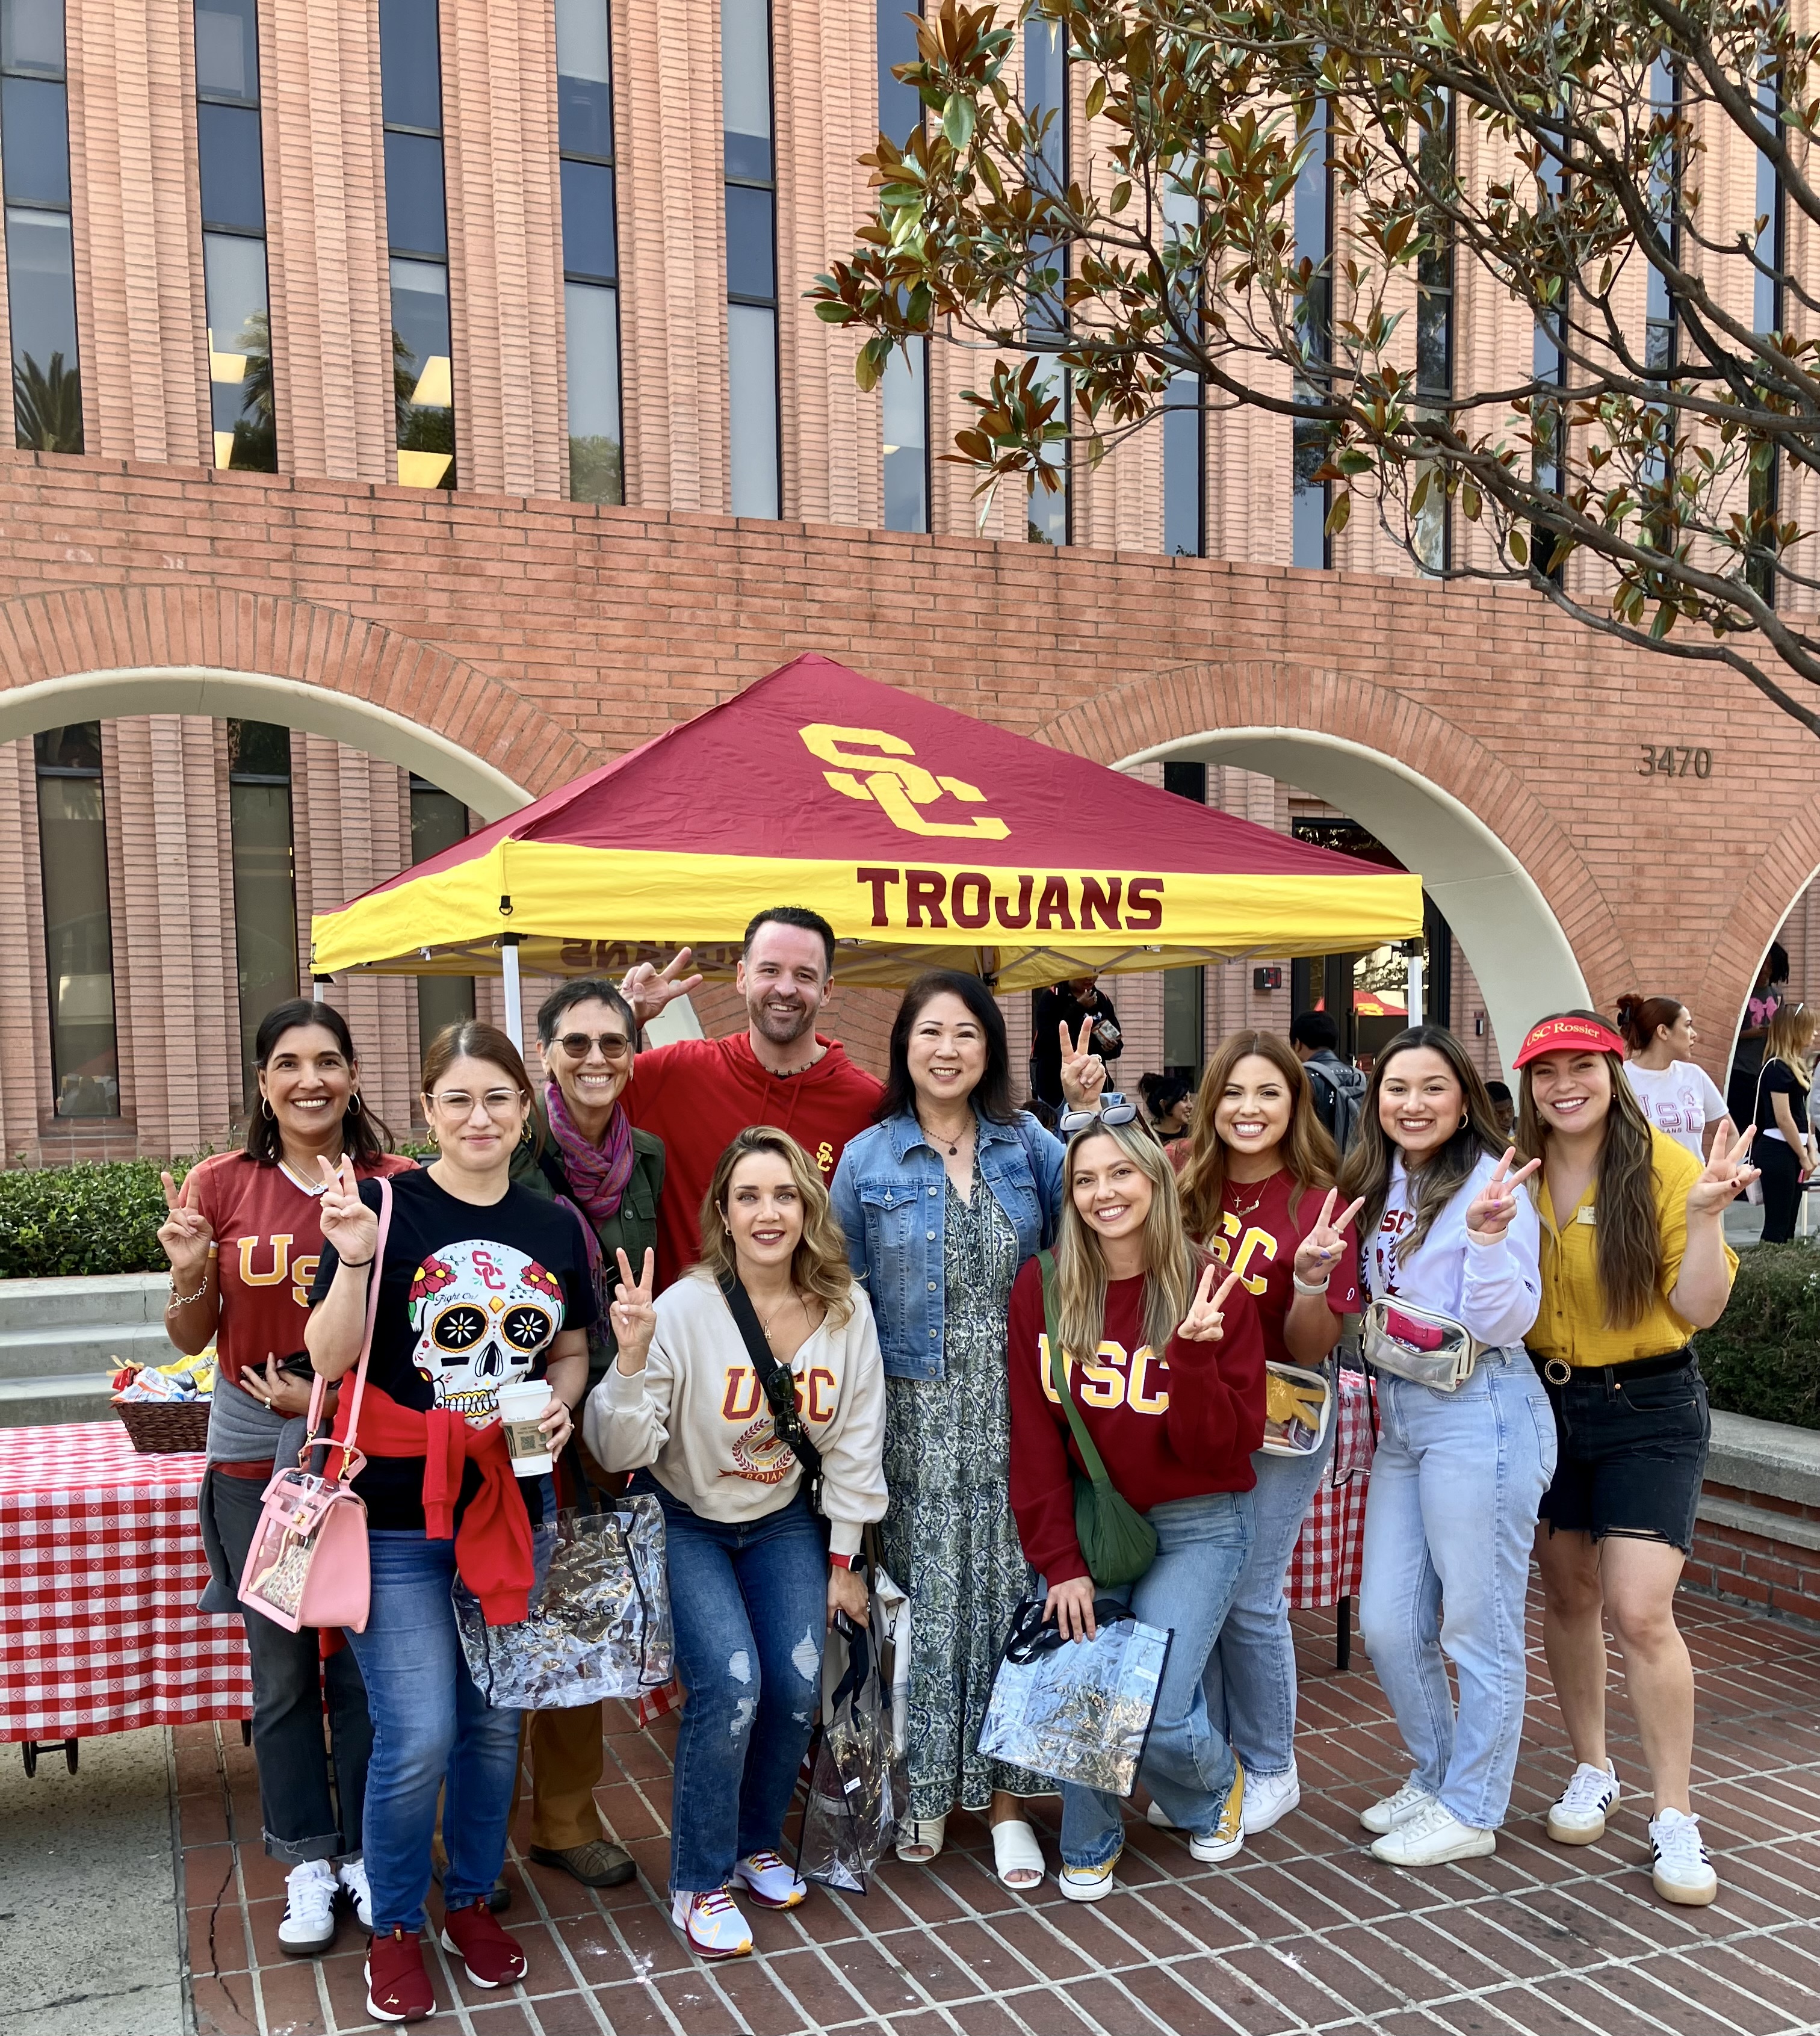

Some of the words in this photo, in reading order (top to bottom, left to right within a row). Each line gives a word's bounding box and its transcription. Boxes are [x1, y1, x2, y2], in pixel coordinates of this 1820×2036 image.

[1639, 744, 1712, 779] 3470
[798, 723, 1012, 840] SC
[857, 867, 1165, 930] TROJANS
[1526, 1026, 1551, 1047] USC
[1553, 1022, 1600, 1038] Rossier
[816, 1142, 834, 1172] SC
[237, 1234, 321, 1307] US
[472, 1250, 506, 1290] SC
[435, 1292, 460, 1306] Fight
[738, 1470, 786, 1483] TROJAN
